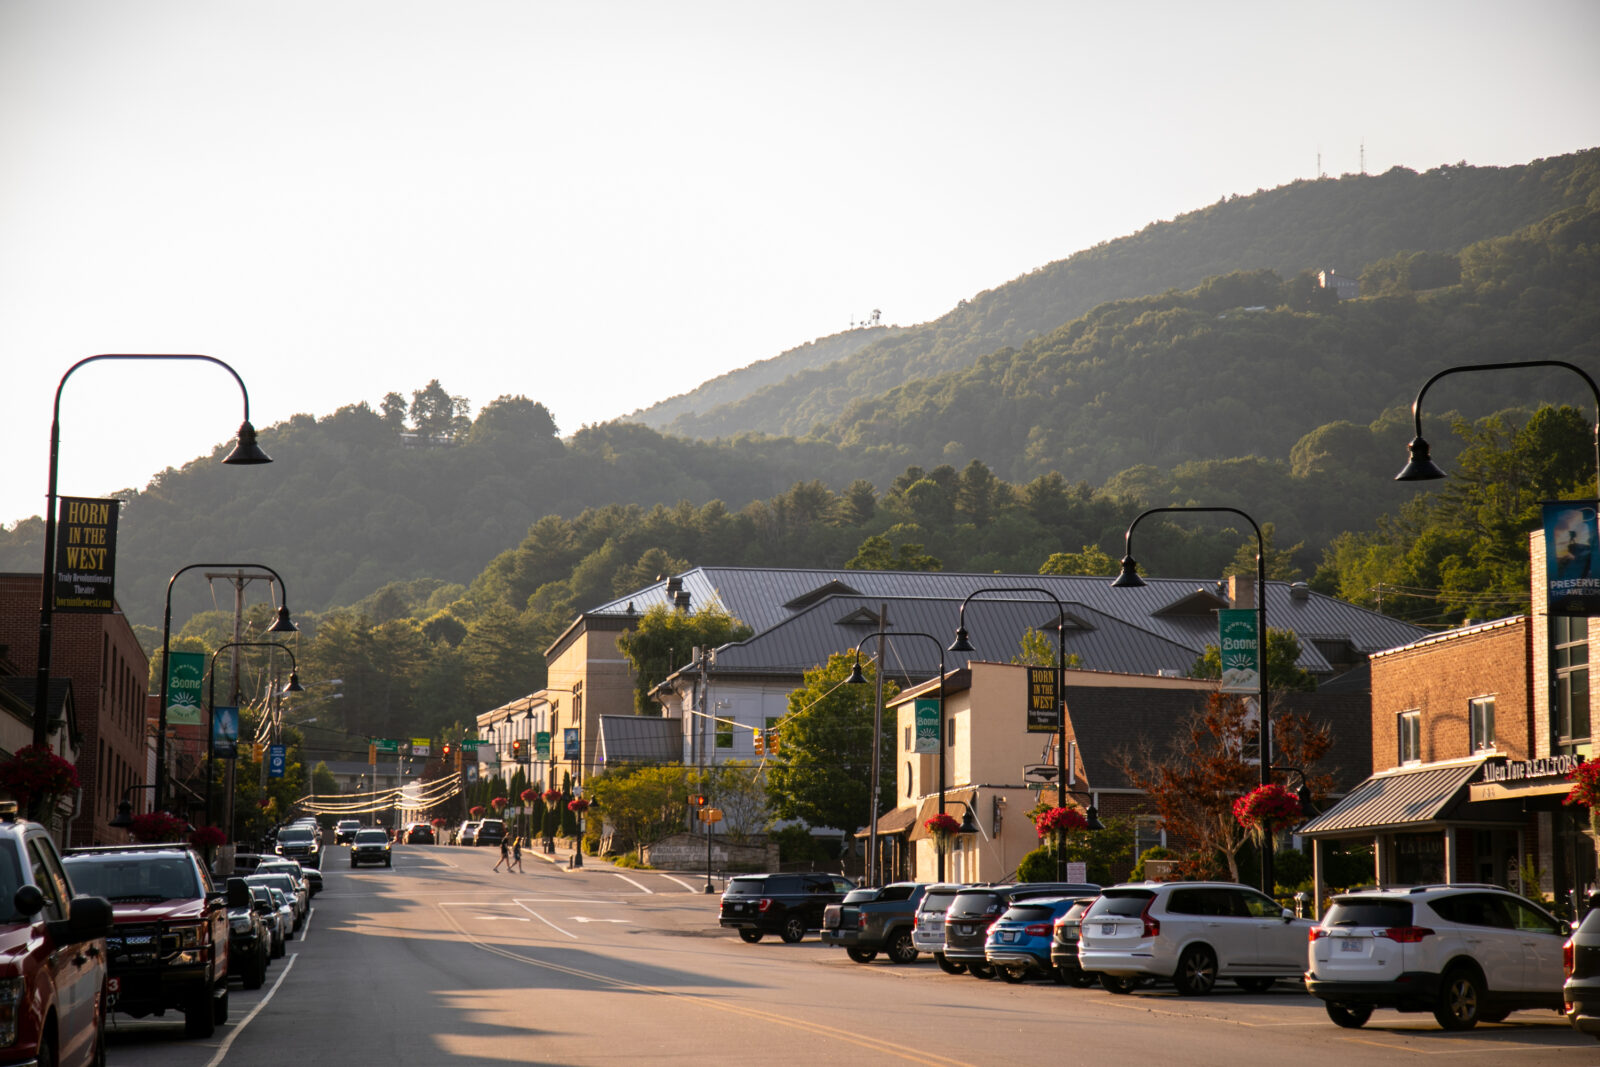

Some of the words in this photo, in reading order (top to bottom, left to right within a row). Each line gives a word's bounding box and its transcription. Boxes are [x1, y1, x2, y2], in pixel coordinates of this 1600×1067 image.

[68, 502, 109, 524] HORN
[68, 527, 81, 544] IN
[84, 527, 106, 545] THE
[66, 547, 107, 570] WEST
[1550, 578, 1600, 589] PRESERVE
[1567, 588, 1583, 596] AWE
[1223, 637, 1257, 650] Boone
[170, 676, 201, 689] Boone
[1032, 670, 1054, 683] HORN
[1033, 684, 1041, 695] IN
[1041, 684, 1054, 695] THE
[1032, 696, 1055, 709] WEST
[1483, 763, 1505, 783] Allen
[1506, 760, 1525, 780] Tate
[1525, 754, 1578, 779] REALTORS
[108, 978, 119, 992] 3
